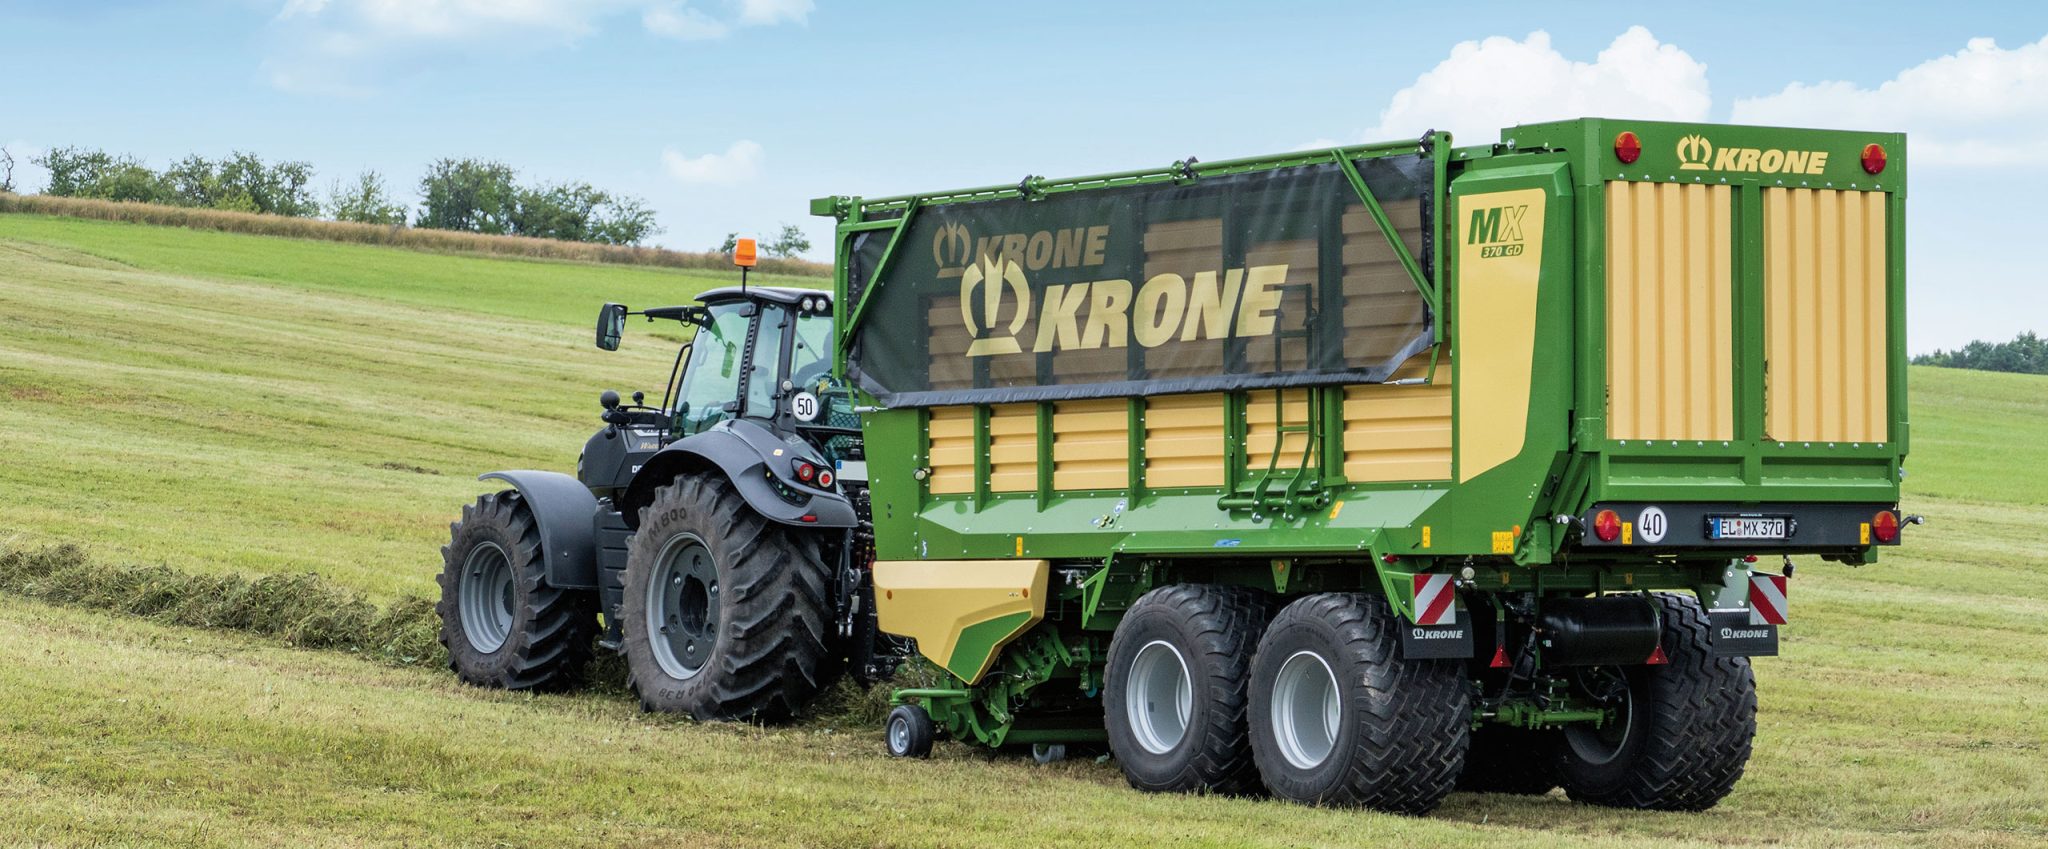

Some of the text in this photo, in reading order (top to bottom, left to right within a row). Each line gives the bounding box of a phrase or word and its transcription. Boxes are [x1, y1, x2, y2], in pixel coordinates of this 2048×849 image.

[1713, 147, 1829, 175] KRONE
[1468, 205, 1528, 245] MX
[975, 225, 1110, 273] KRONE
[1483, 245, 1522, 258] 370 GD
[1032, 264, 1289, 353] KRONE
[797, 397, 813, 416] 50
[1643, 513, 1662, 536] 40
[1721, 521, 1783, 536] EL MX 370
[1425, 630, 1464, 639] KRONE
[1732, 629, 1769, 639] KRONE
